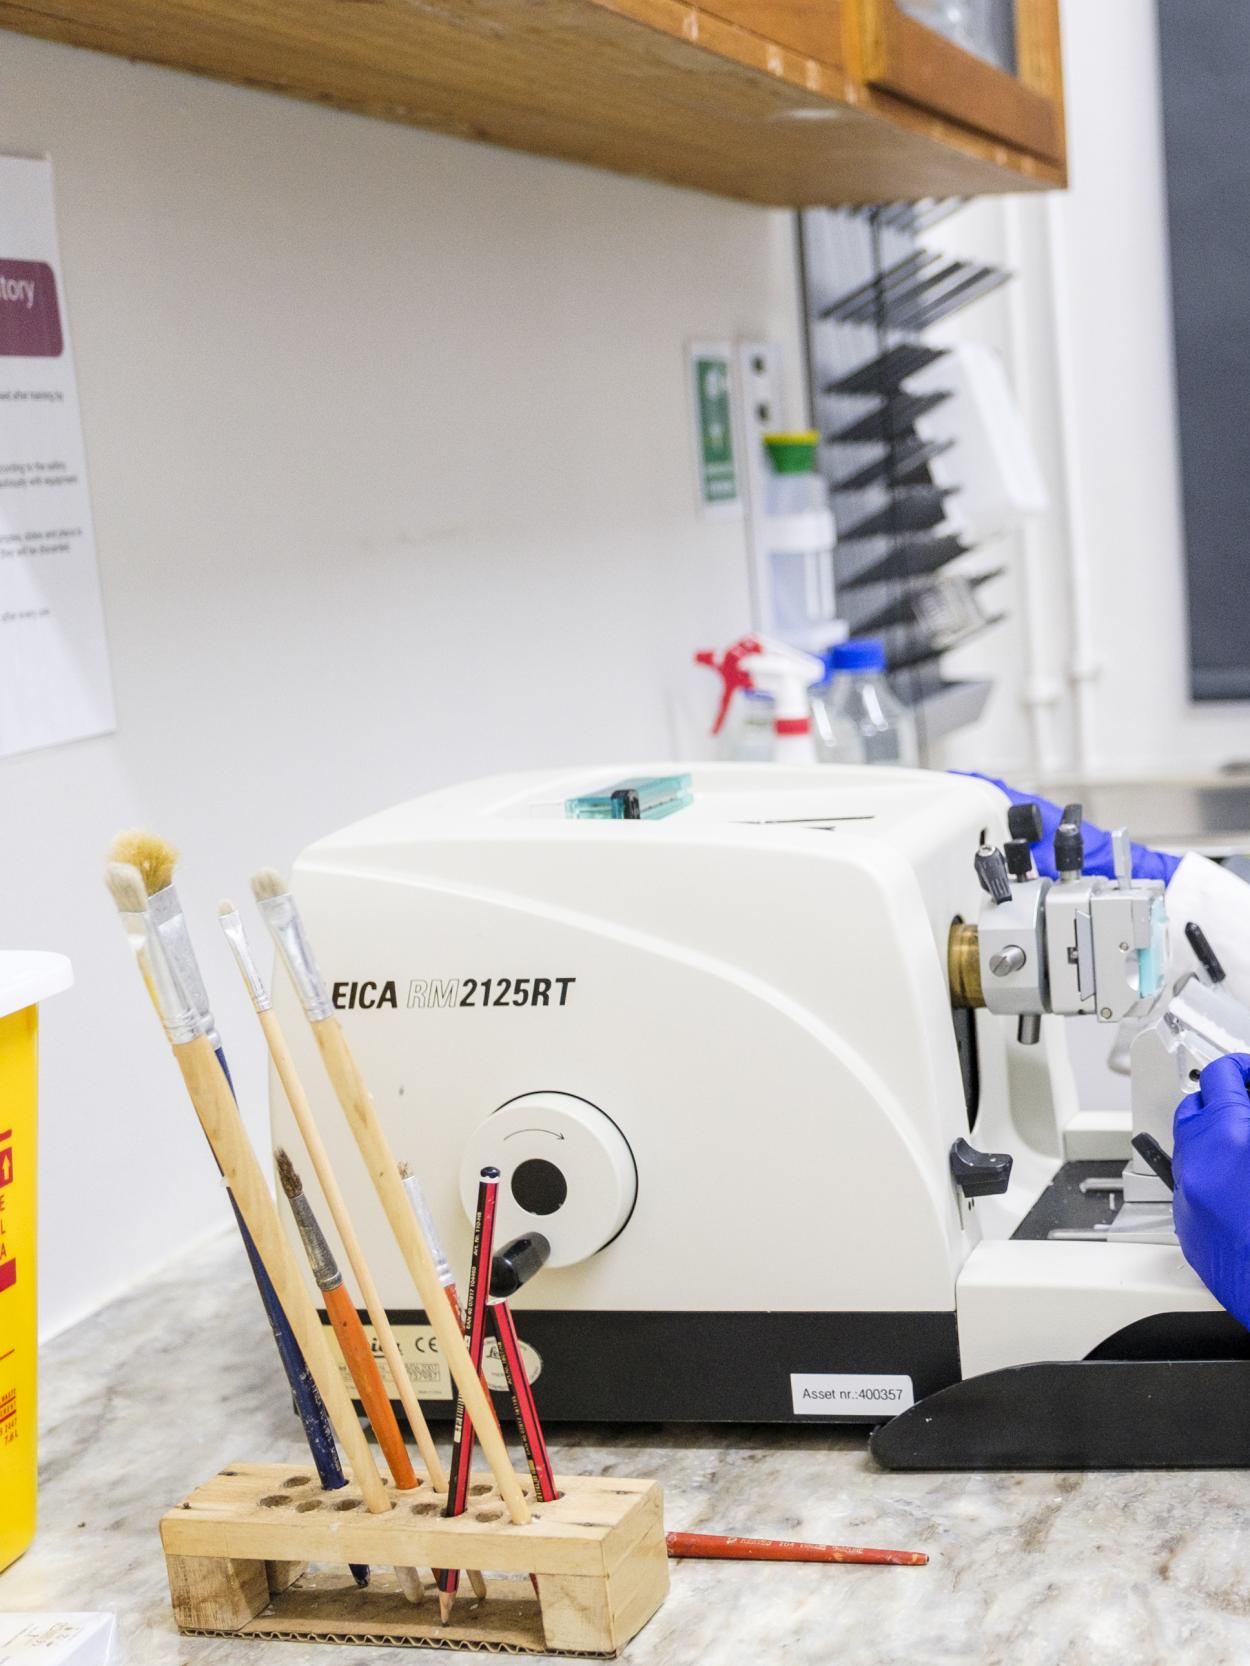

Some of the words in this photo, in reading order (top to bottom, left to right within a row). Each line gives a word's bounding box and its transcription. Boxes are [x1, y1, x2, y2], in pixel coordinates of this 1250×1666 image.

[332, 981, 398, 1009] EICA
[407, 977, 576, 1008] RM2125RT
[803, 1388, 836, 1400] Asset
[840, 1389, 903, 1401] nr.:400357
